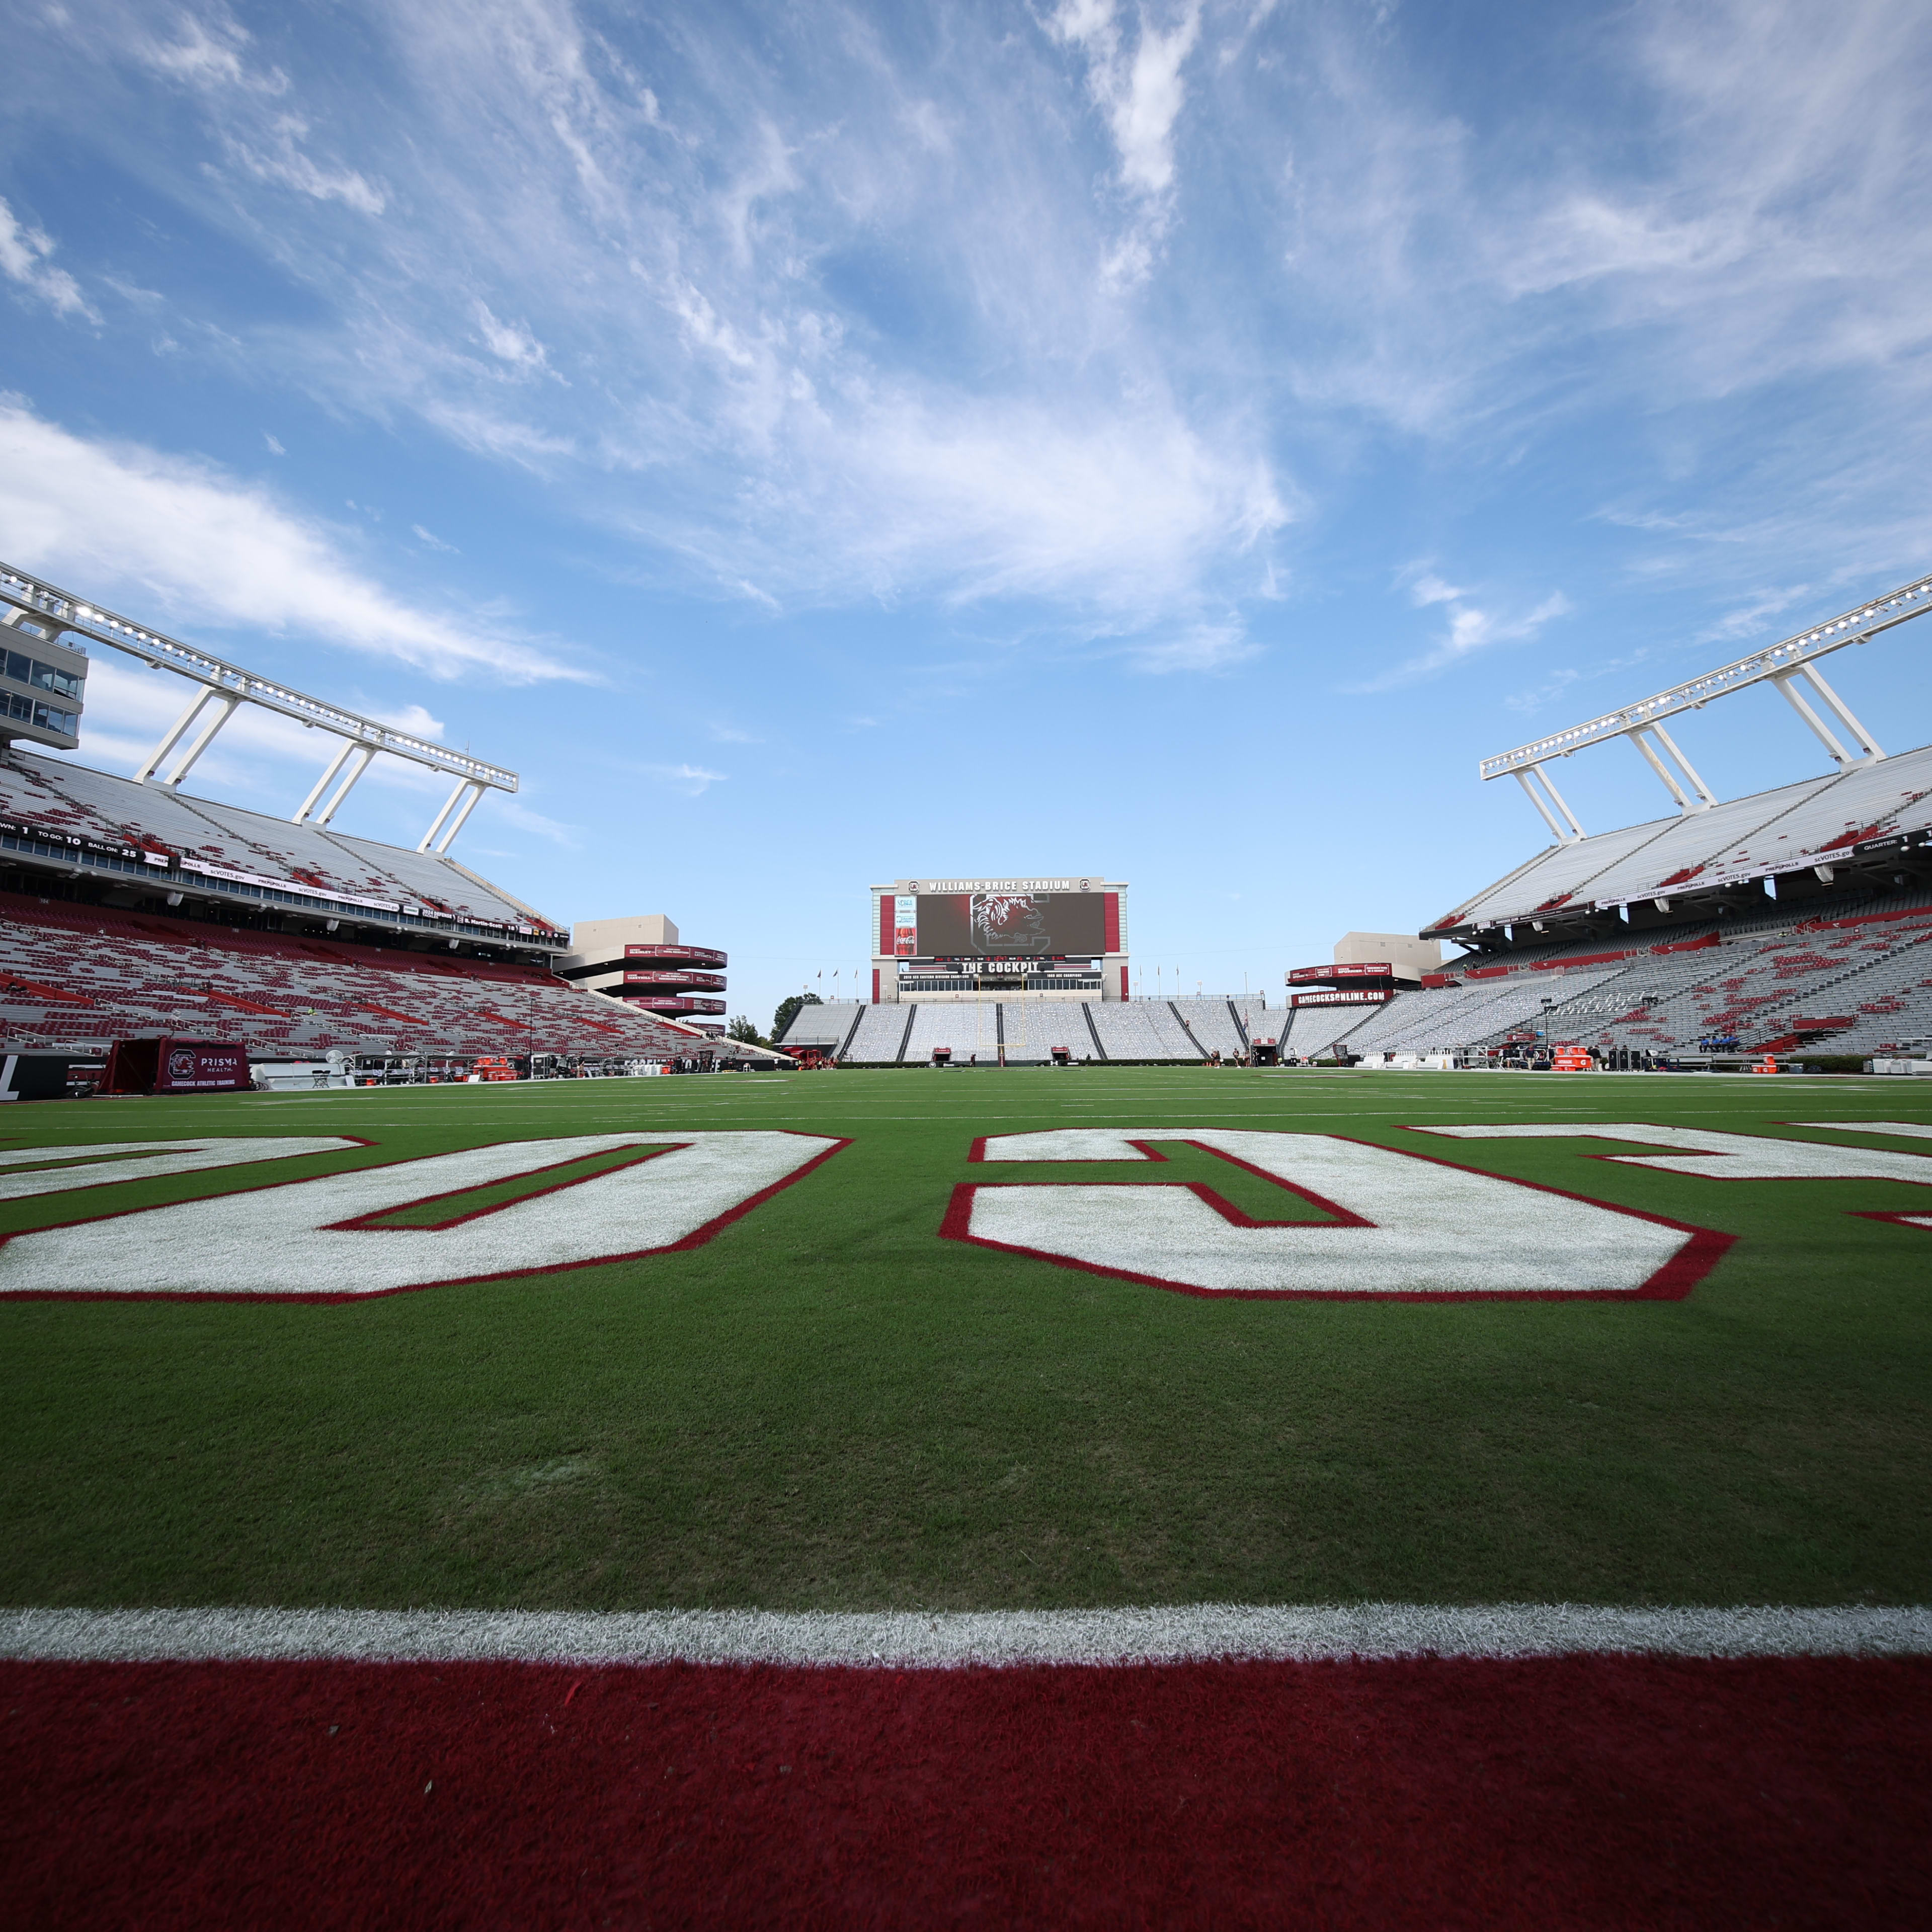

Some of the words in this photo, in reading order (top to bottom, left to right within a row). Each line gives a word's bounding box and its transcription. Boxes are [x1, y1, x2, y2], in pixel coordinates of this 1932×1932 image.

[66, 836, 81, 845] 10
[1864, 839, 1898, 850] QUARTER:
[88, 842, 106, 851] BALL
[122, 849, 136, 857] 25
[210, 869, 245, 880] scVOTES.gov
[1718, 872, 1751, 882] scVOTES.gov
[929, 881, 1017, 892] WILLIAMS-BRICE
[1022, 880, 1070, 891] STADIUM
[298, 888, 327, 897] scVOTES.gov
[1637, 890, 1665, 899] scVOTES.gov
[471, 919, 503, 929] Martin-Scott
[897, 936, 914, 945] Coca-Cola
[962, 963, 983, 973] THE
[988, 962, 1038, 973] COCKPIT
[1298, 992, 1384, 1004] GAMECOCKSONLINE.COM
